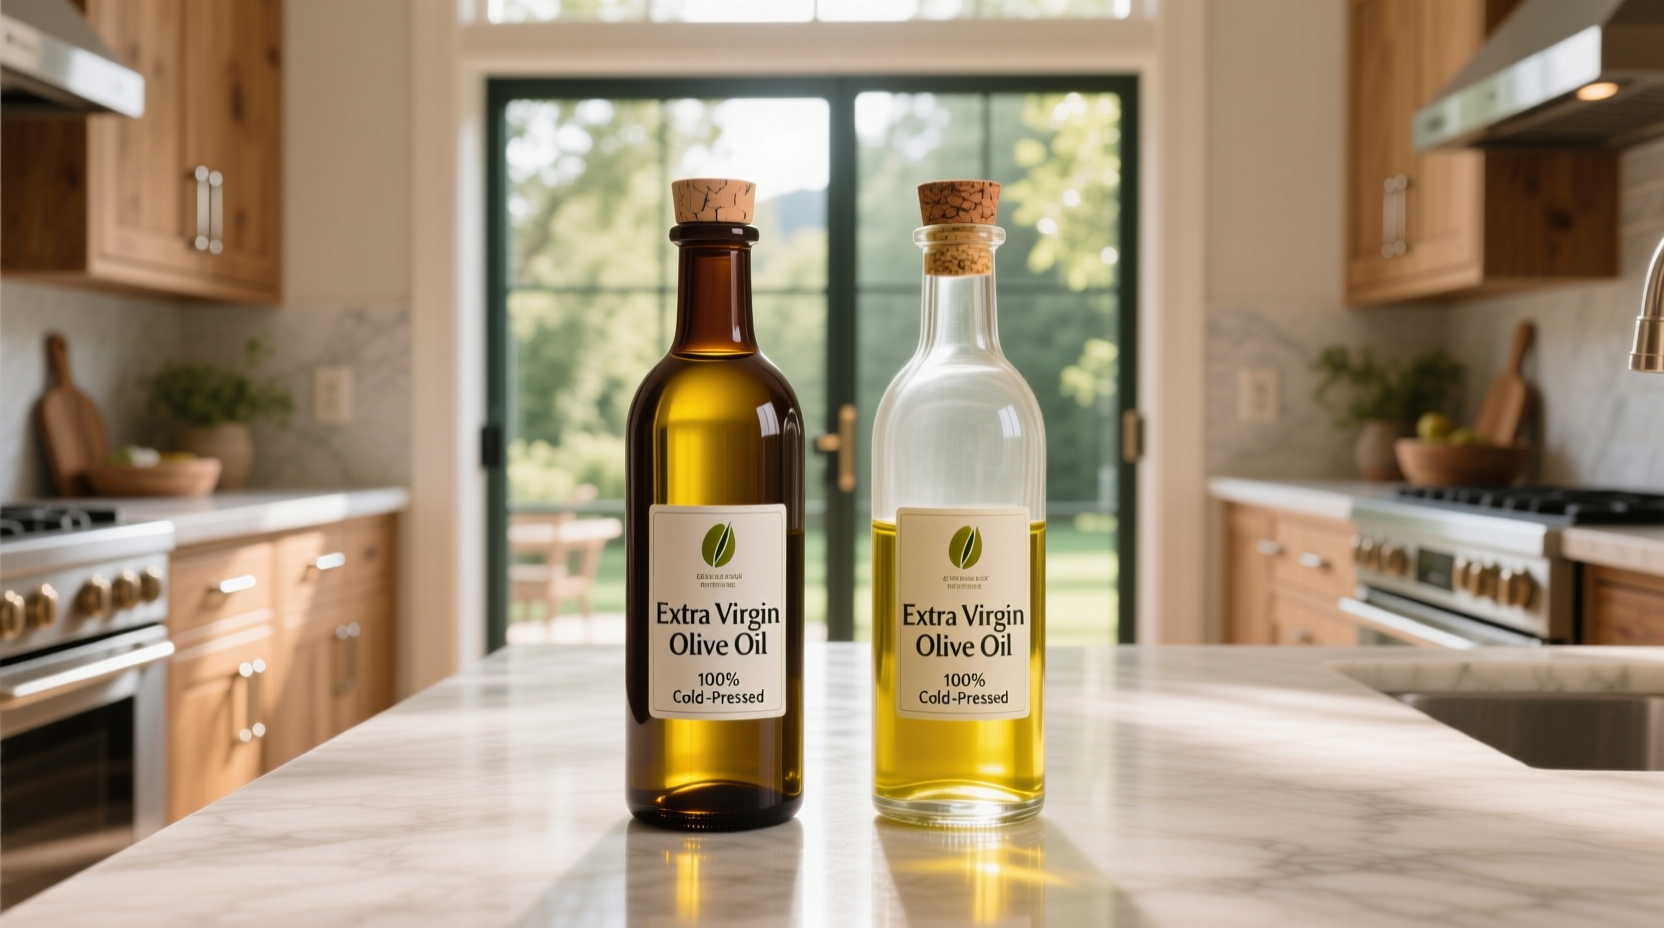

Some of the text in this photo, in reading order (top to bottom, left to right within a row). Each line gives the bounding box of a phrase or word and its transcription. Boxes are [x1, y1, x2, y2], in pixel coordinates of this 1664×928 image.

[656, 601, 780, 631] Extra Virgin
[902, 603, 1024, 632] Extra Virgin
[669, 631, 768, 656] Olive Oil
[915, 632, 1013, 657] Olive Oil
[697, 671, 740, 686] 100%
[943, 672, 986, 688] 100%
[672, 689, 765, 704] Cold-Pressed
[918, 689, 1009, 705] Cold-Pressed
